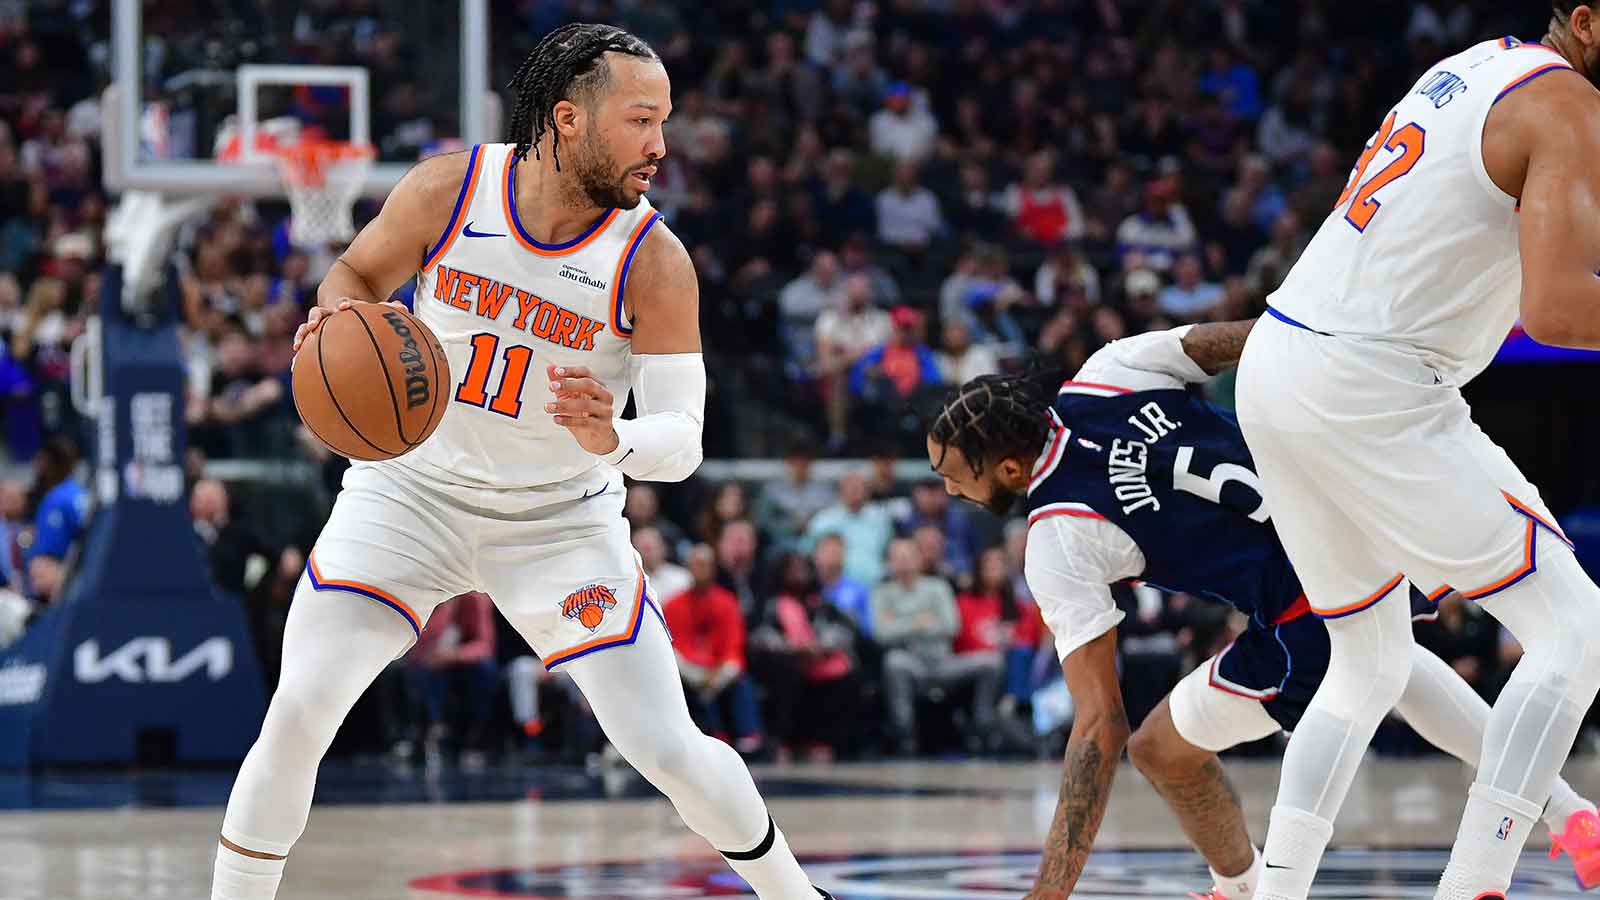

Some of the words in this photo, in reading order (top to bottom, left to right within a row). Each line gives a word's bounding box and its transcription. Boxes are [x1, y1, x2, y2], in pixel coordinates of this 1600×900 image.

[1334, 110, 1426, 233] 32
[434, 264, 512, 320] NEW
[513, 290, 606, 351] YORK
[559, 270, 578, 281] abu
[579, 275, 607, 290] dhabi
[383, 311, 429, 411] Wilson
[455, 332, 533, 419] 11
[1128, 401, 1182, 444] JR.
[1108, 438, 1160, 515] JONES
[1173, 446, 1272, 523] 5
[562, 585, 618, 618] KNICKS
